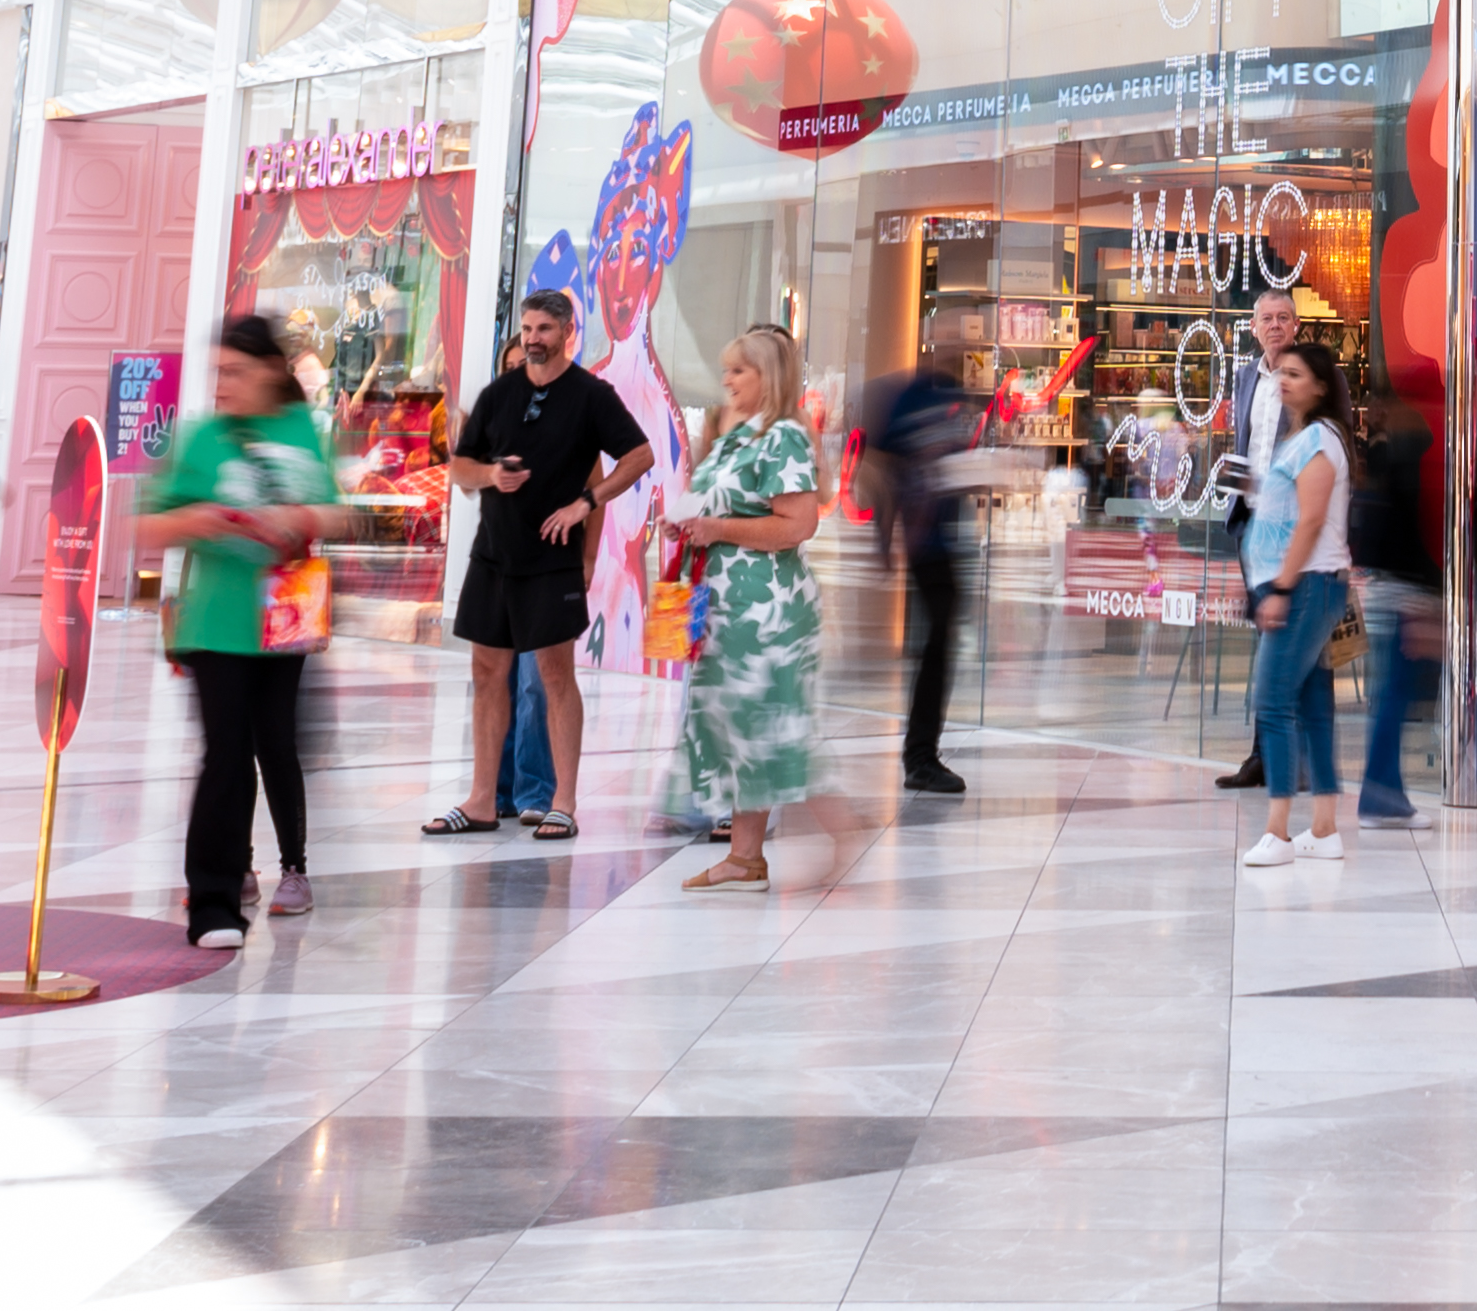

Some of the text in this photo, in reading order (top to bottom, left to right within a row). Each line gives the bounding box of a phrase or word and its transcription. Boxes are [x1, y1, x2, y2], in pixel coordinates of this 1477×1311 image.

[1266, 62, 1375, 88] MECCA
[1058, 82, 1115, 109] MECCA
[1165, 46, 1270, 157] THE
[780, 113, 860, 139] PERFUMERIA
[882, 105, 932, 129] MECCA
[1130, 180, 1308, 296] MAGIC
[340, 272, 387, 303] SEASON
[121, 357, 163, 380] 20%
[1175, 318, 1254, 427] OF
[119, 380, 151, 400] OFF
[118, 414, 139, 427] YOU
[120, 401, 148, 414] WHEN
[118, 429, 140, 441] BUY
[117, 443, 128, 455] 2!
[1086, 590, 1145, 618] MECCA
